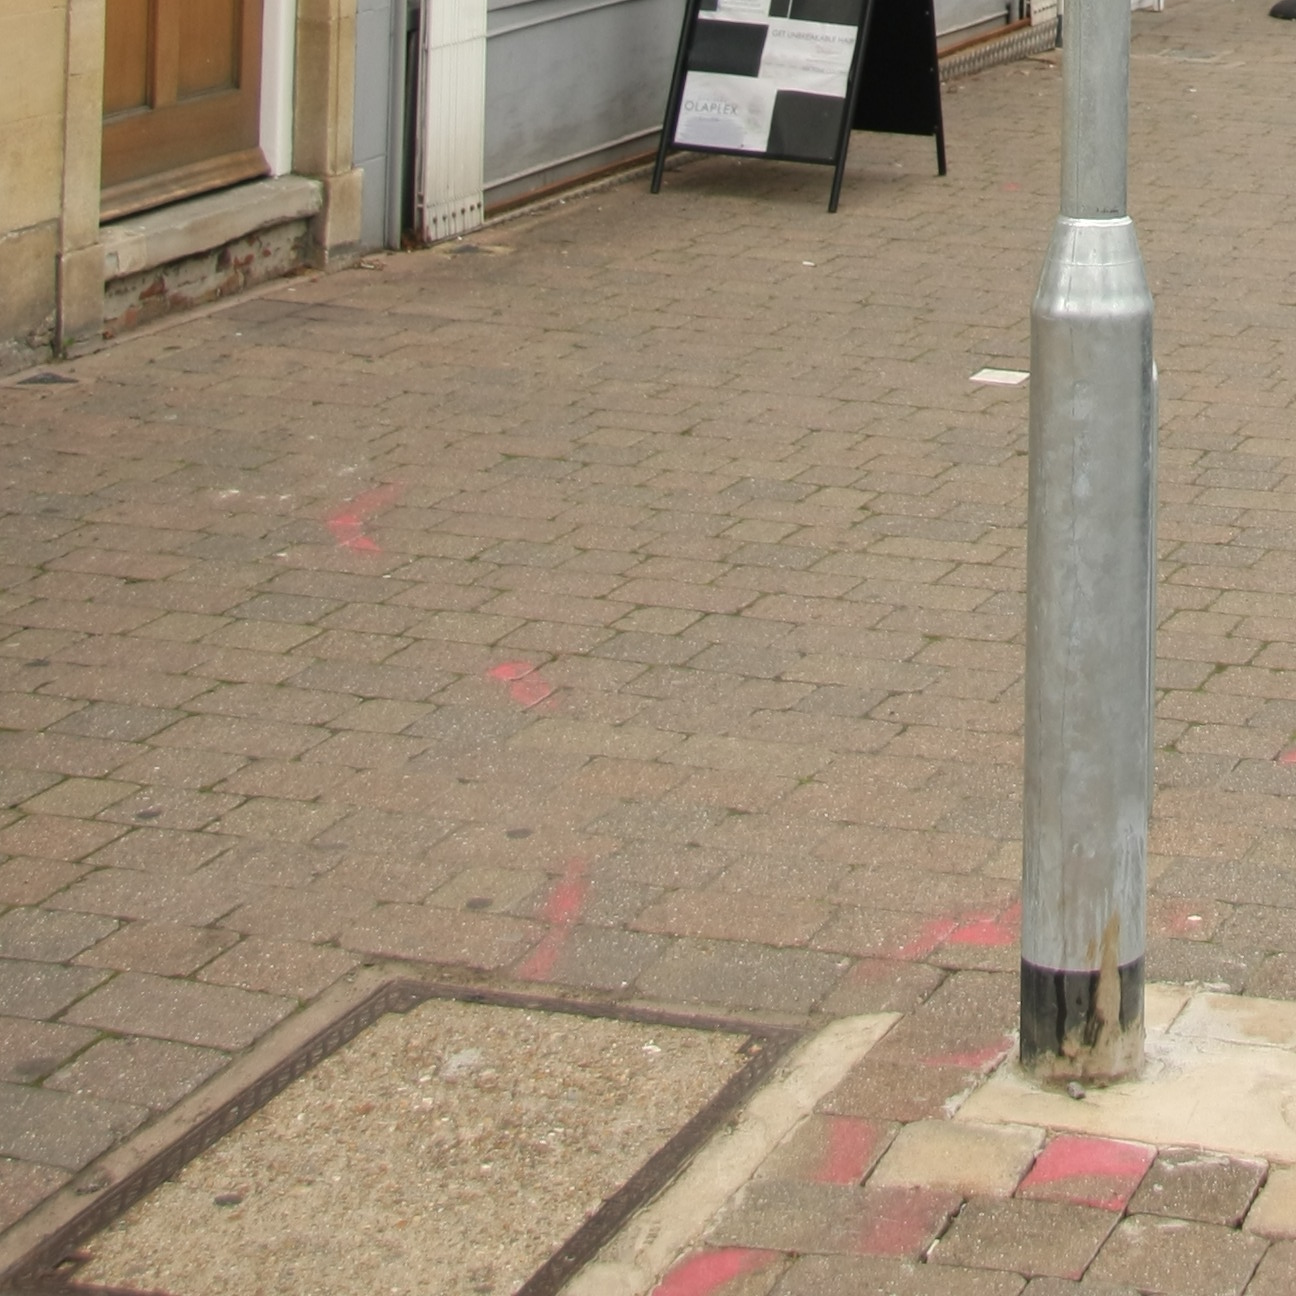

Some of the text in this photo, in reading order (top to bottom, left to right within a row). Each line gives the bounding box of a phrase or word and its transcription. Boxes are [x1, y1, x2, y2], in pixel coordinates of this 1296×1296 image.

[772, 29, 786, 39] GET
[787, 30, 836, 44] UNBREAKABLE
[684, 99, 738, 116] OLAPLEX
